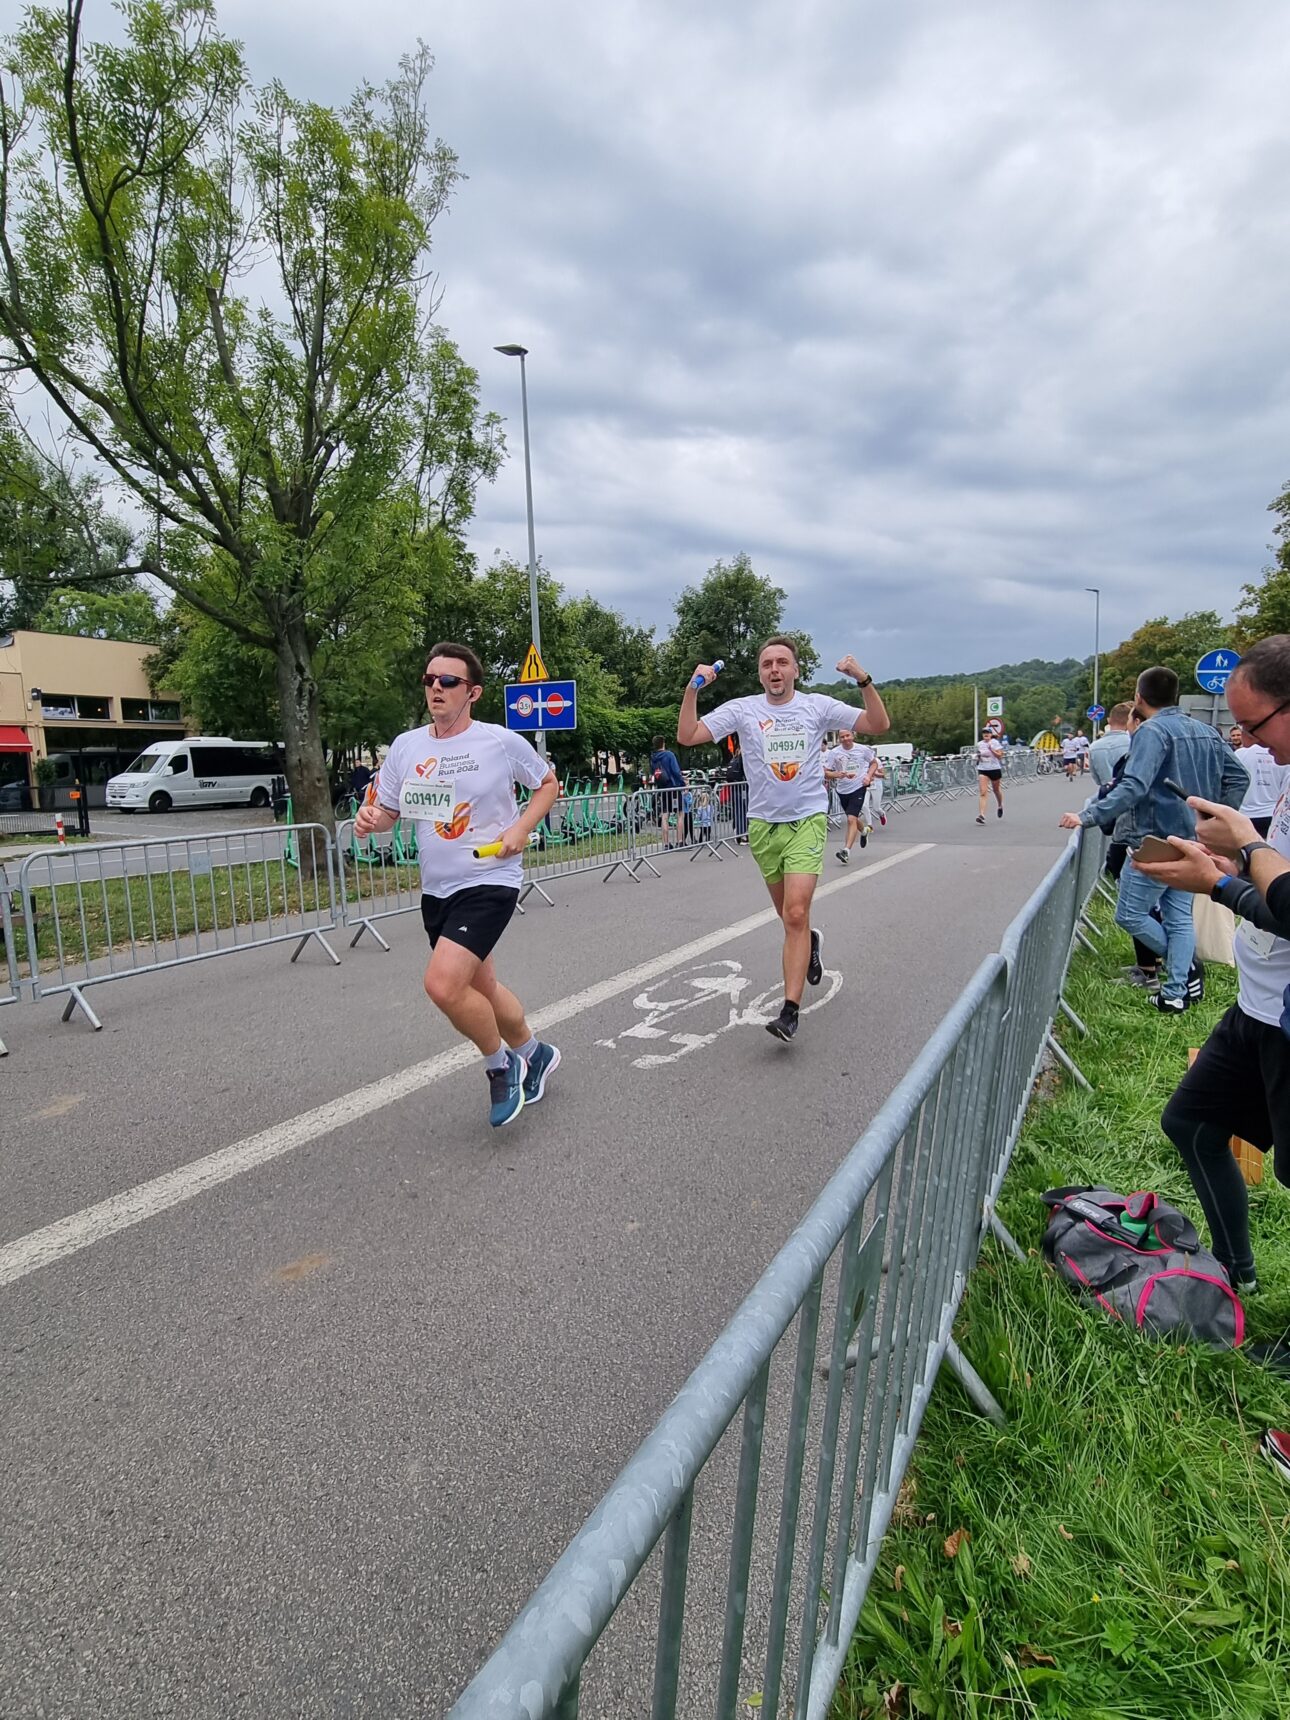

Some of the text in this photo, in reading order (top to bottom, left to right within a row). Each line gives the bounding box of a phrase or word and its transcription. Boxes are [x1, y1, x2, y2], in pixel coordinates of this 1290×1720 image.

[767, 739, 805, 752] J0493/4
[440, 753, 470, 763] Poland
[438, 764, 479, 776] Run 2022
[439, 760, 476, 770] Business
[404, 791, 451, 808] C0141/4
